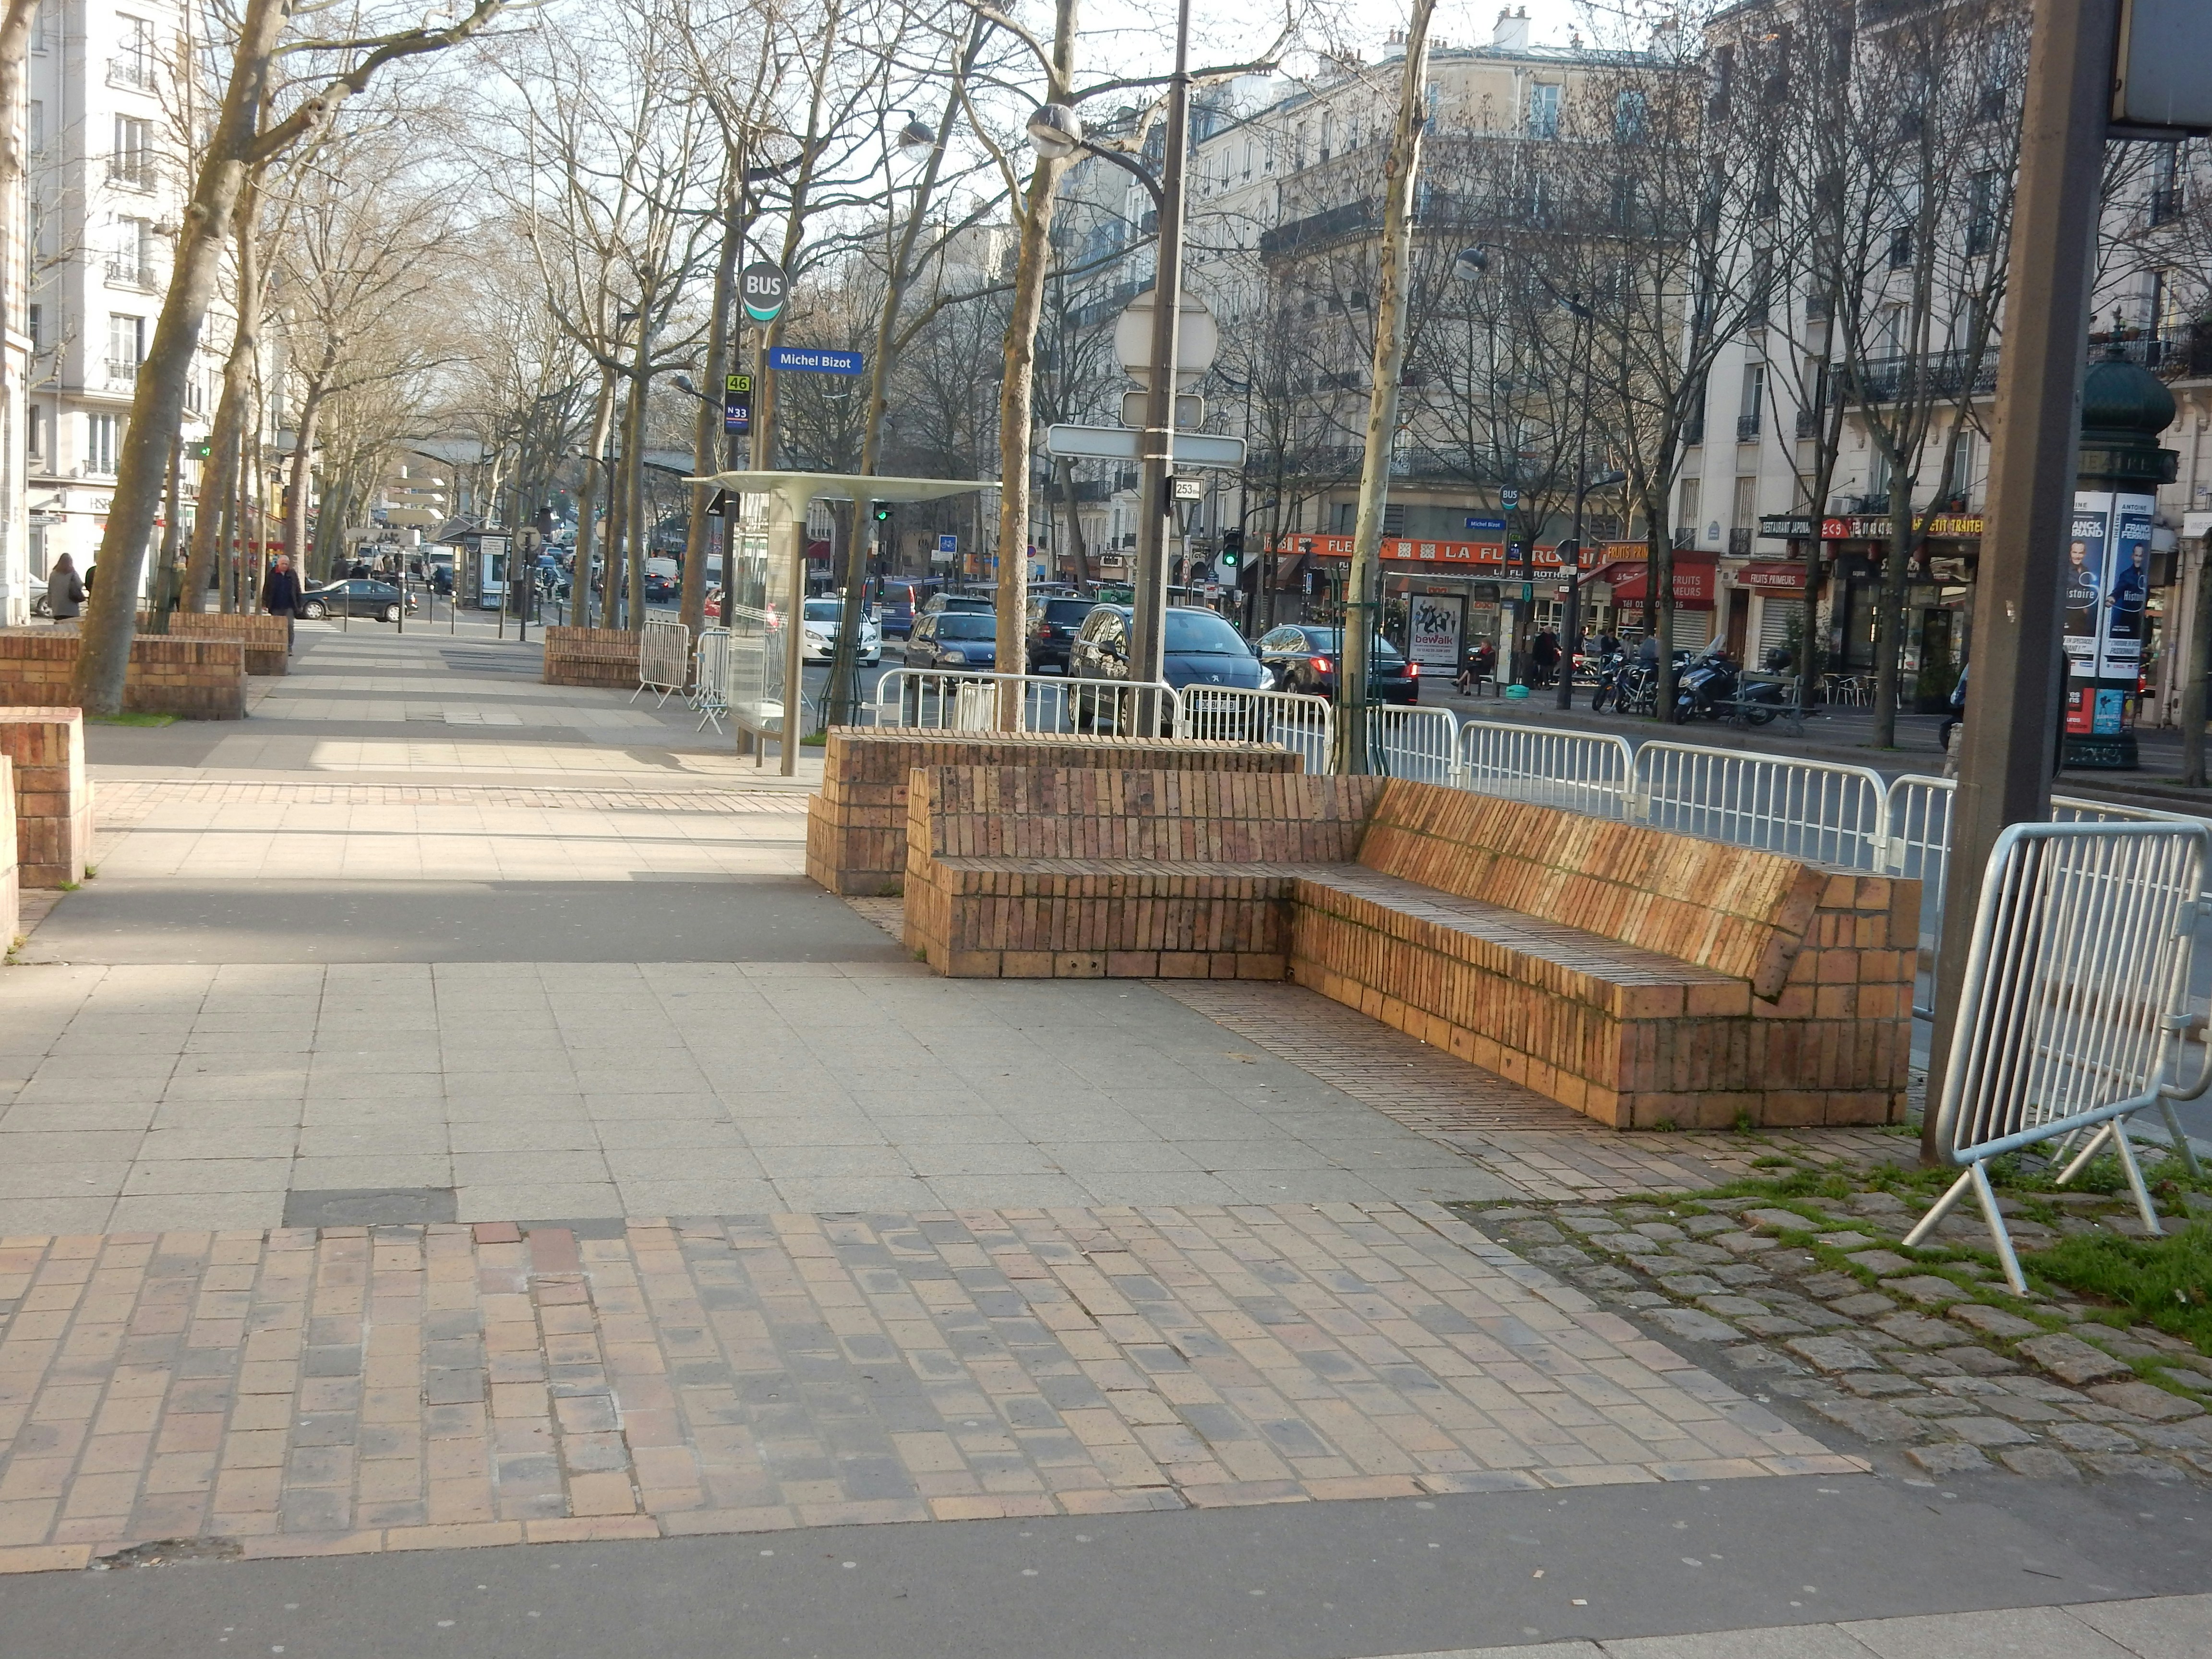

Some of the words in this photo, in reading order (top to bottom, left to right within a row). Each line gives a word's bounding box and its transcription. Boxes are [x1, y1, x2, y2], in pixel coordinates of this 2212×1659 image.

[746, 276, 781, 296] BUS
[781, 353, 818, 366] Michel
[822, 356, 851, 369] Bizot
[730, 377, 747, 389] 46
[1503, 490, 1517, 499] BUS
[90, 498, 111, 509] HSB
[1763, 521, 1790, 533] RESTAURANT
[1791, 522, 1810, 533] JAPONA
[1929, 519, 1947, 531] ETIT
[1951, 519, 1984, 532] TRAITE
[2072, 521, 2101, 529] ANCK
[1446, 546, 1470, 558] LA
[1608, 546, 1630, 558] FRUITS
[1672, 576, 1701, 585] FRUITS
[1751, 574, 1767, 583] FRUITS
[1769, 575, 1795, 585] PRIMEURS
[2067, 588, 2094, 599] istoire
[1623, 600, 1632, 608] Tél
[1415, 634, 1453, 644] bewalk
